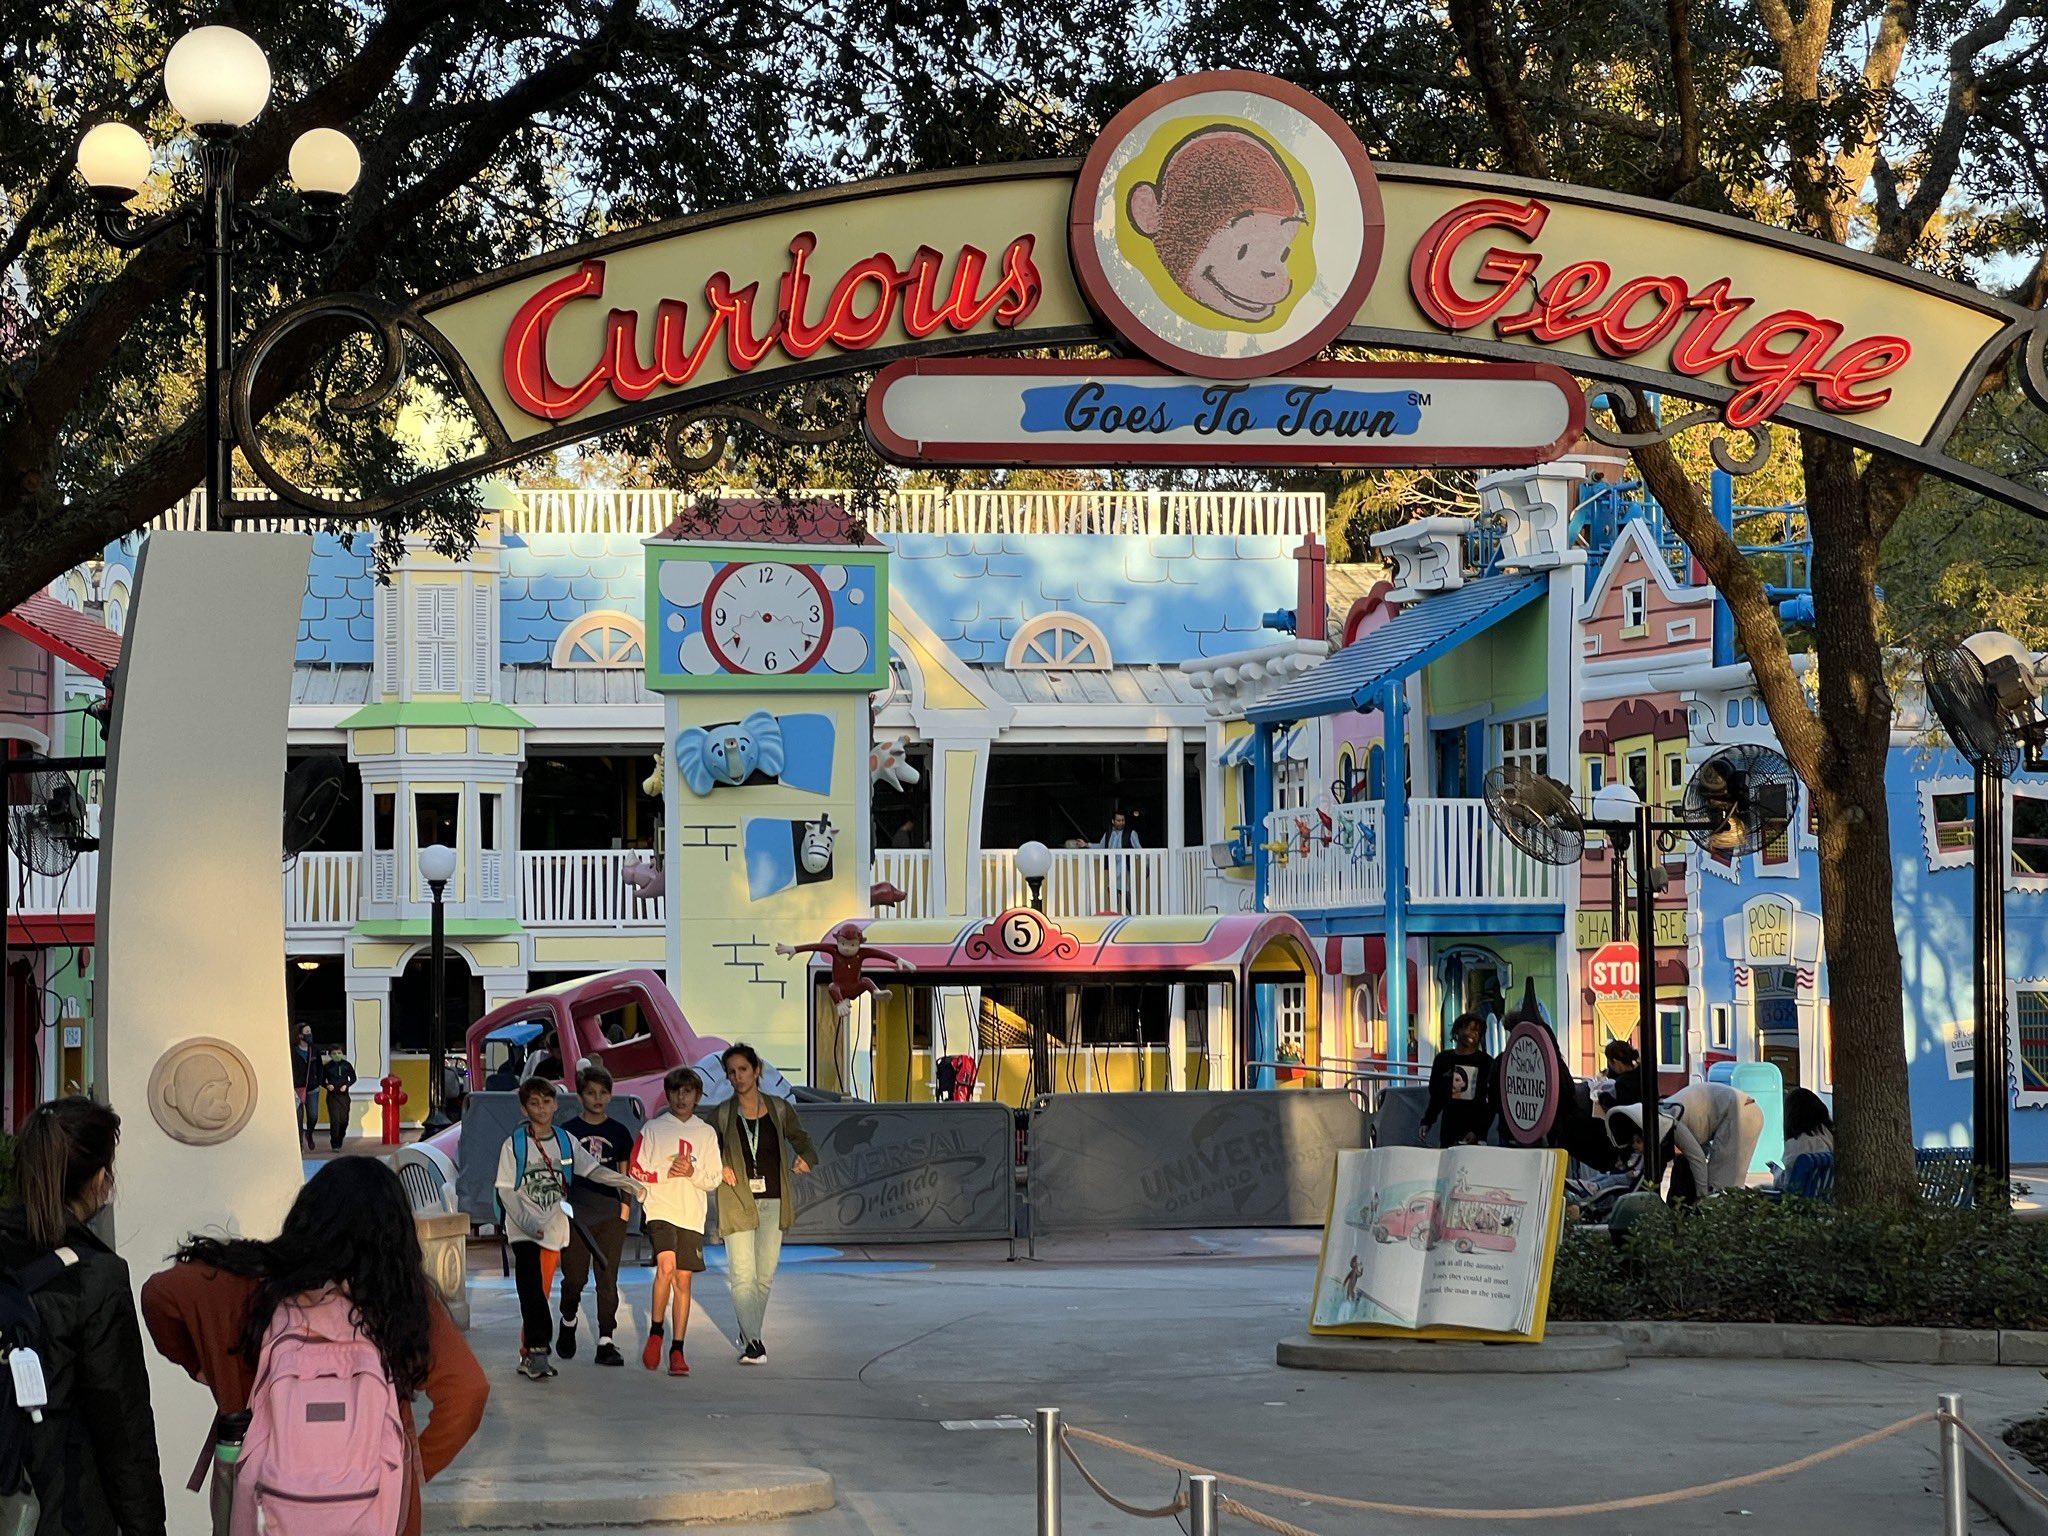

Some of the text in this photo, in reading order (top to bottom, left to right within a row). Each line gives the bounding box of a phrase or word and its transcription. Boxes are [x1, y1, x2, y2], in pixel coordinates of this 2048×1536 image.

[503, 198, 1912, 430] Curious George
[1063, 381, 1431, 439] Goes To Town SM
[758, 567, 774, 583] 12
[715, 608, 727, 626] 9
[809, 605, 821, 623] 3
[764, 652, 777, 671] 6
[1588, 911, 1678, 944] HAARE
[1748, 903, 1786, 934] POST
[1013, 919, 1031, 948] 5
[1749, 932, 1788, 958] OFFICE
[1510, 1040, 1541, 1070] ANIMAL
[1516, 1058, 1536, 1074] SHOW
[1506, 1075, 1545, 1099] PARKING
[1515, 1100, 1539, 1121] ONLY
[837, 1166, 938, 1226] Orlando
[879, 1197, 932, 1219] RESORT
[1464, 1260, 1474, 1268] the
